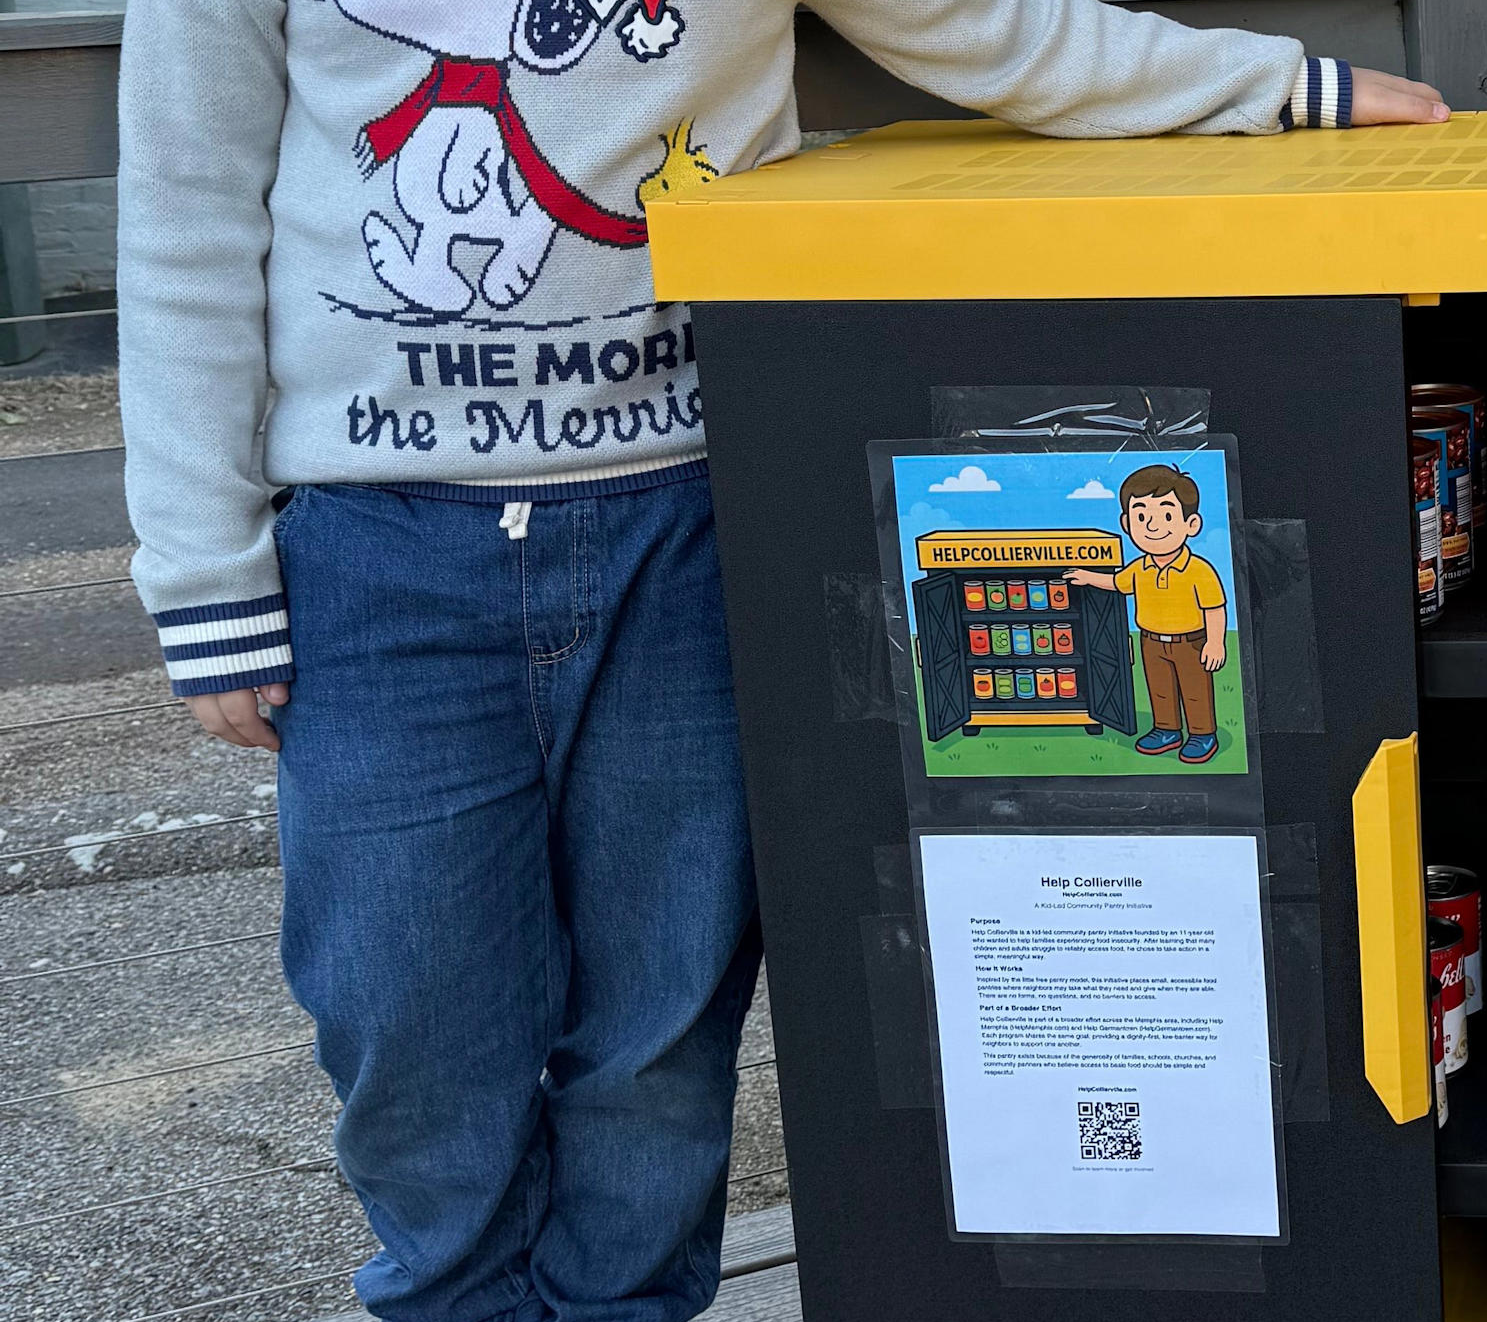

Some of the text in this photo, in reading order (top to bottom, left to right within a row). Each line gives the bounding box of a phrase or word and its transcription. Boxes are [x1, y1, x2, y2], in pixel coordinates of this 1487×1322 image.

[398, 342, 519, 387] THE
[347, 394, 437, 451] the
[933, 545, 1113, 562] HELPCOLLIERVILLE.COM
[1041, 877, 1142, 889] Help Collierville
[1063, 891, 1122, 899] HelpCollierville.com
[1041, 902, 1065, 910] Kid-Led
[1067, 902, 1102, 911] Community
[1105, 902, 1125, 911] Pantry
[1126, 902, 1152, 910] Initiative
[970, 917, 1001, 926] Purpose
[1054, 929, 1086, 937] community
[997, 953, 1030, 961] meaningful
[1000, 965, 1023, 973] Works
[1012, 1005, 1039, 1013] Broader
[1042, 1005, 1062, 1013] Effort
